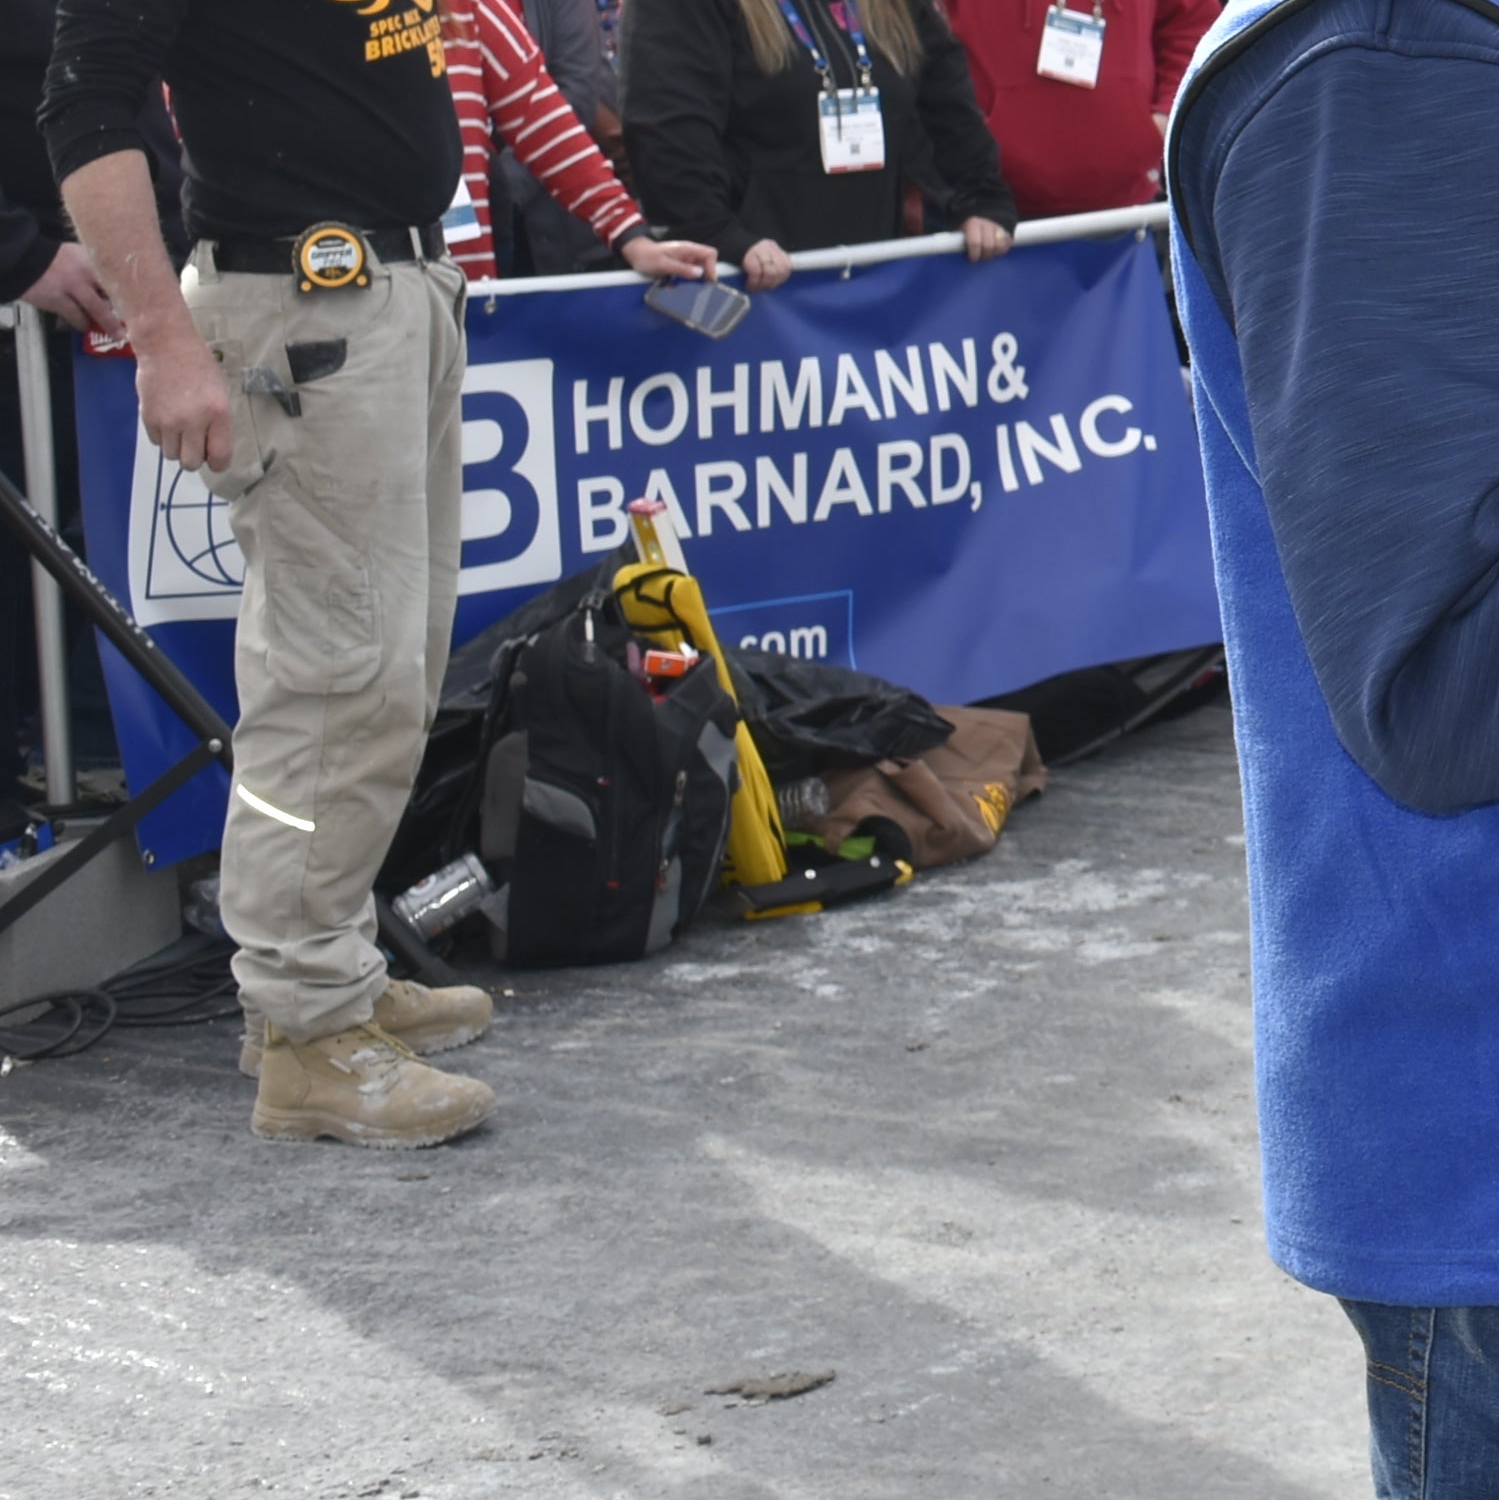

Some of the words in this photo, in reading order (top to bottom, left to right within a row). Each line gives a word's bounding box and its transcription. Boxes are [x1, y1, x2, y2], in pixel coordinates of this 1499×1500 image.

[370, 15, 402, 38] SPEC
[578, 433, 982, 553] BARNARD,
[995, 394, 1158, 492] INC.
